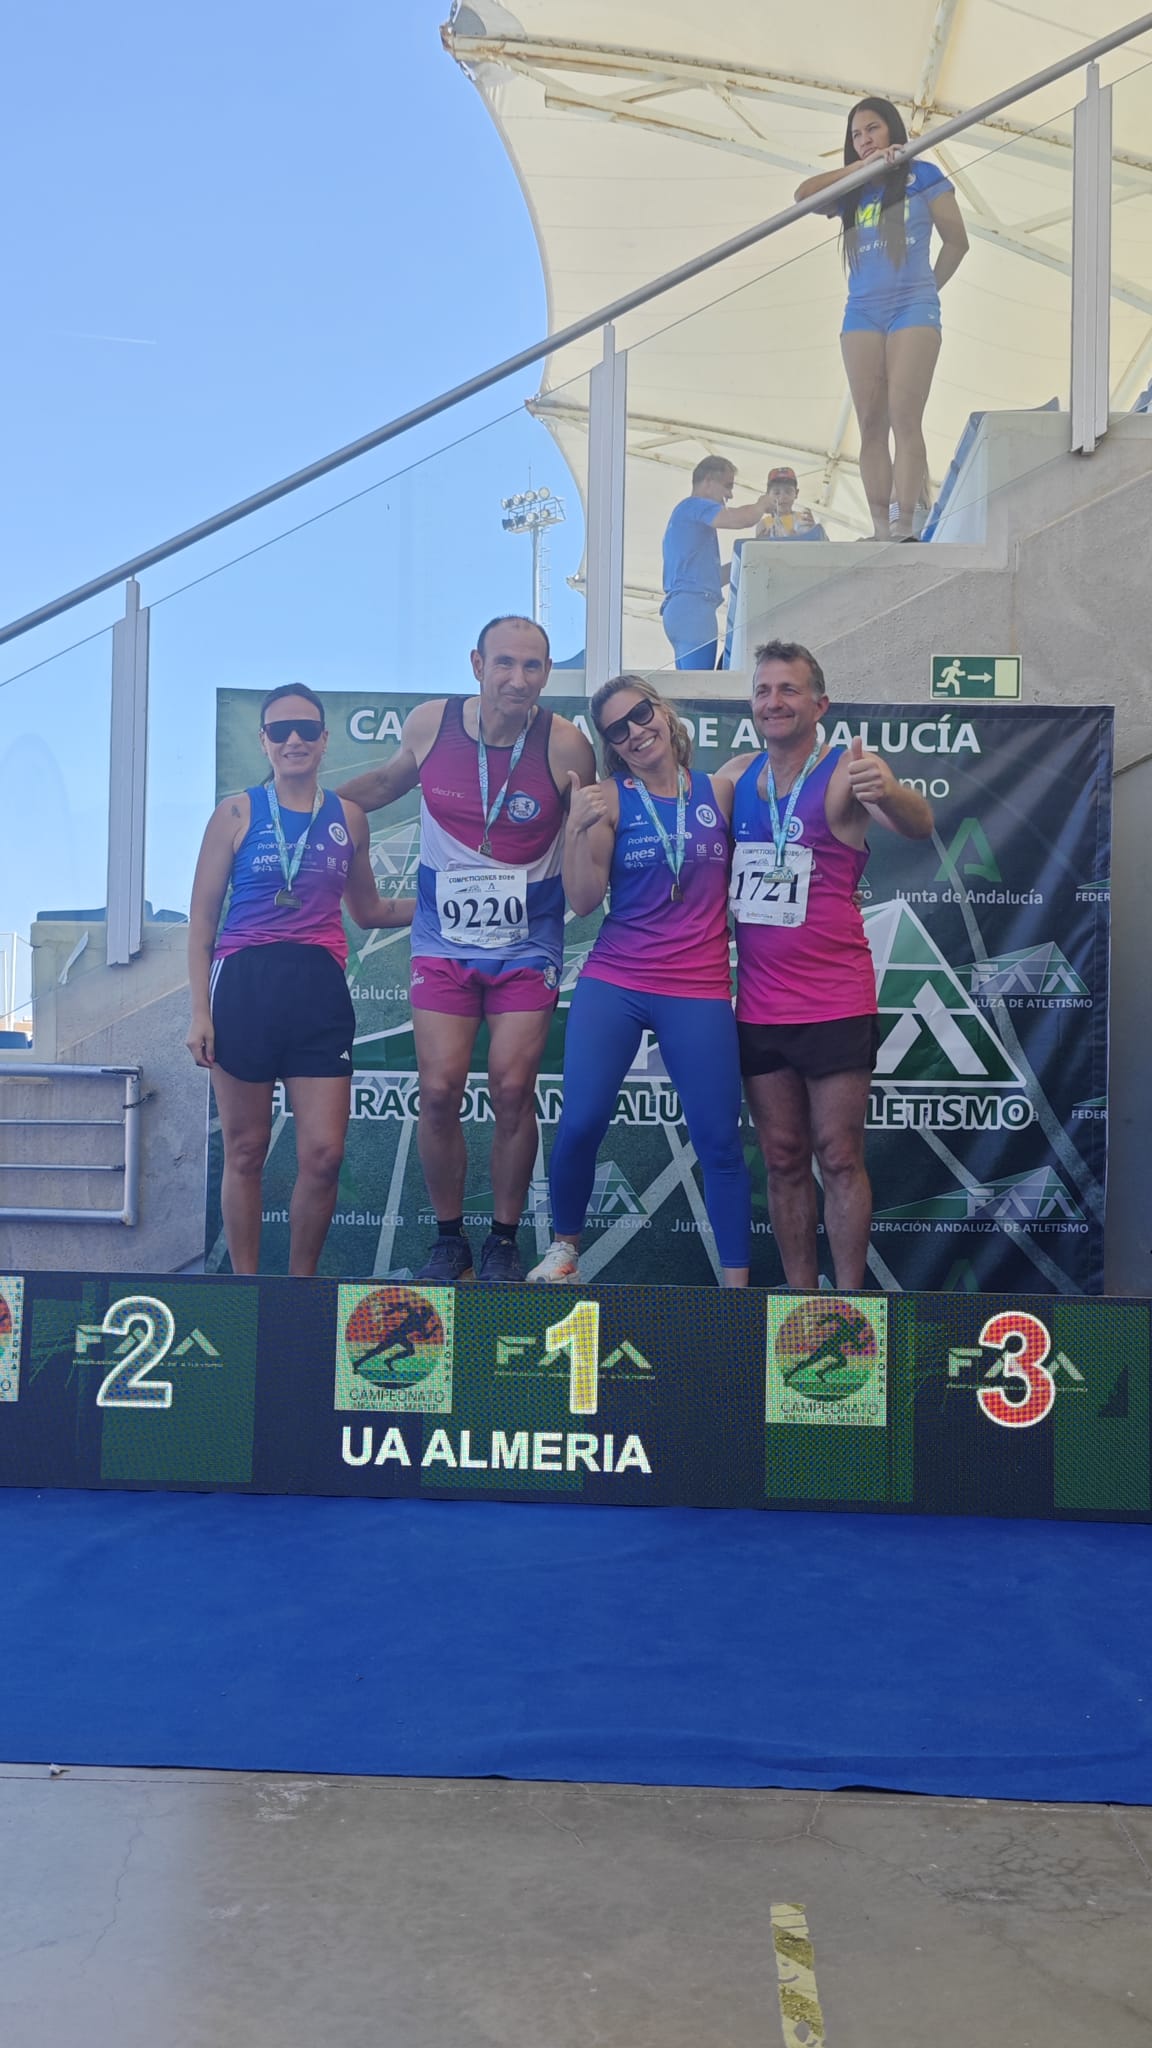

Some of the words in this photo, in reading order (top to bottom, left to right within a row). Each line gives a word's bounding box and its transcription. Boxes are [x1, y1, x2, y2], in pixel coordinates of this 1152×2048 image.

[731, 714, 981, 753] AALUCÍA
[895, 888, 937, 903] Junta
[942, 888, 961, 903] de
[966, 889, 1043, 905] Andalucía
[443, 896, 523, 930] 9220
[1009, 998, 1024, 1008] DE
[1026, 998, 1093, 1009] ATLETISMO
[865, 1096, 1032, 1129] LETISMO
[331, 1211, 404, 1226] ndalucía
[585, 1217, 652, 1229] ATLETISMO
[871, 1220, 931, 1232] DERACIÓN
[934, 1222, 1000, 1232] ANDALUZA
[1003, 1222, 1019, 1232] DE
[1022, 1222, 1088, 1233] ATLETISMO
[96, 1296, 175, 1408] 2
[546, 1300, 600, 1414] 1
[976, 1311, 1056, 1428] 3
[349, 1388, 444, 1402] CAMPEONATO
[780, 1401, 878, 1415] CAMPEONATO
[342, 1426, 412, 1466] UA
[421, 1429, 653, 1473] ALMERIA
